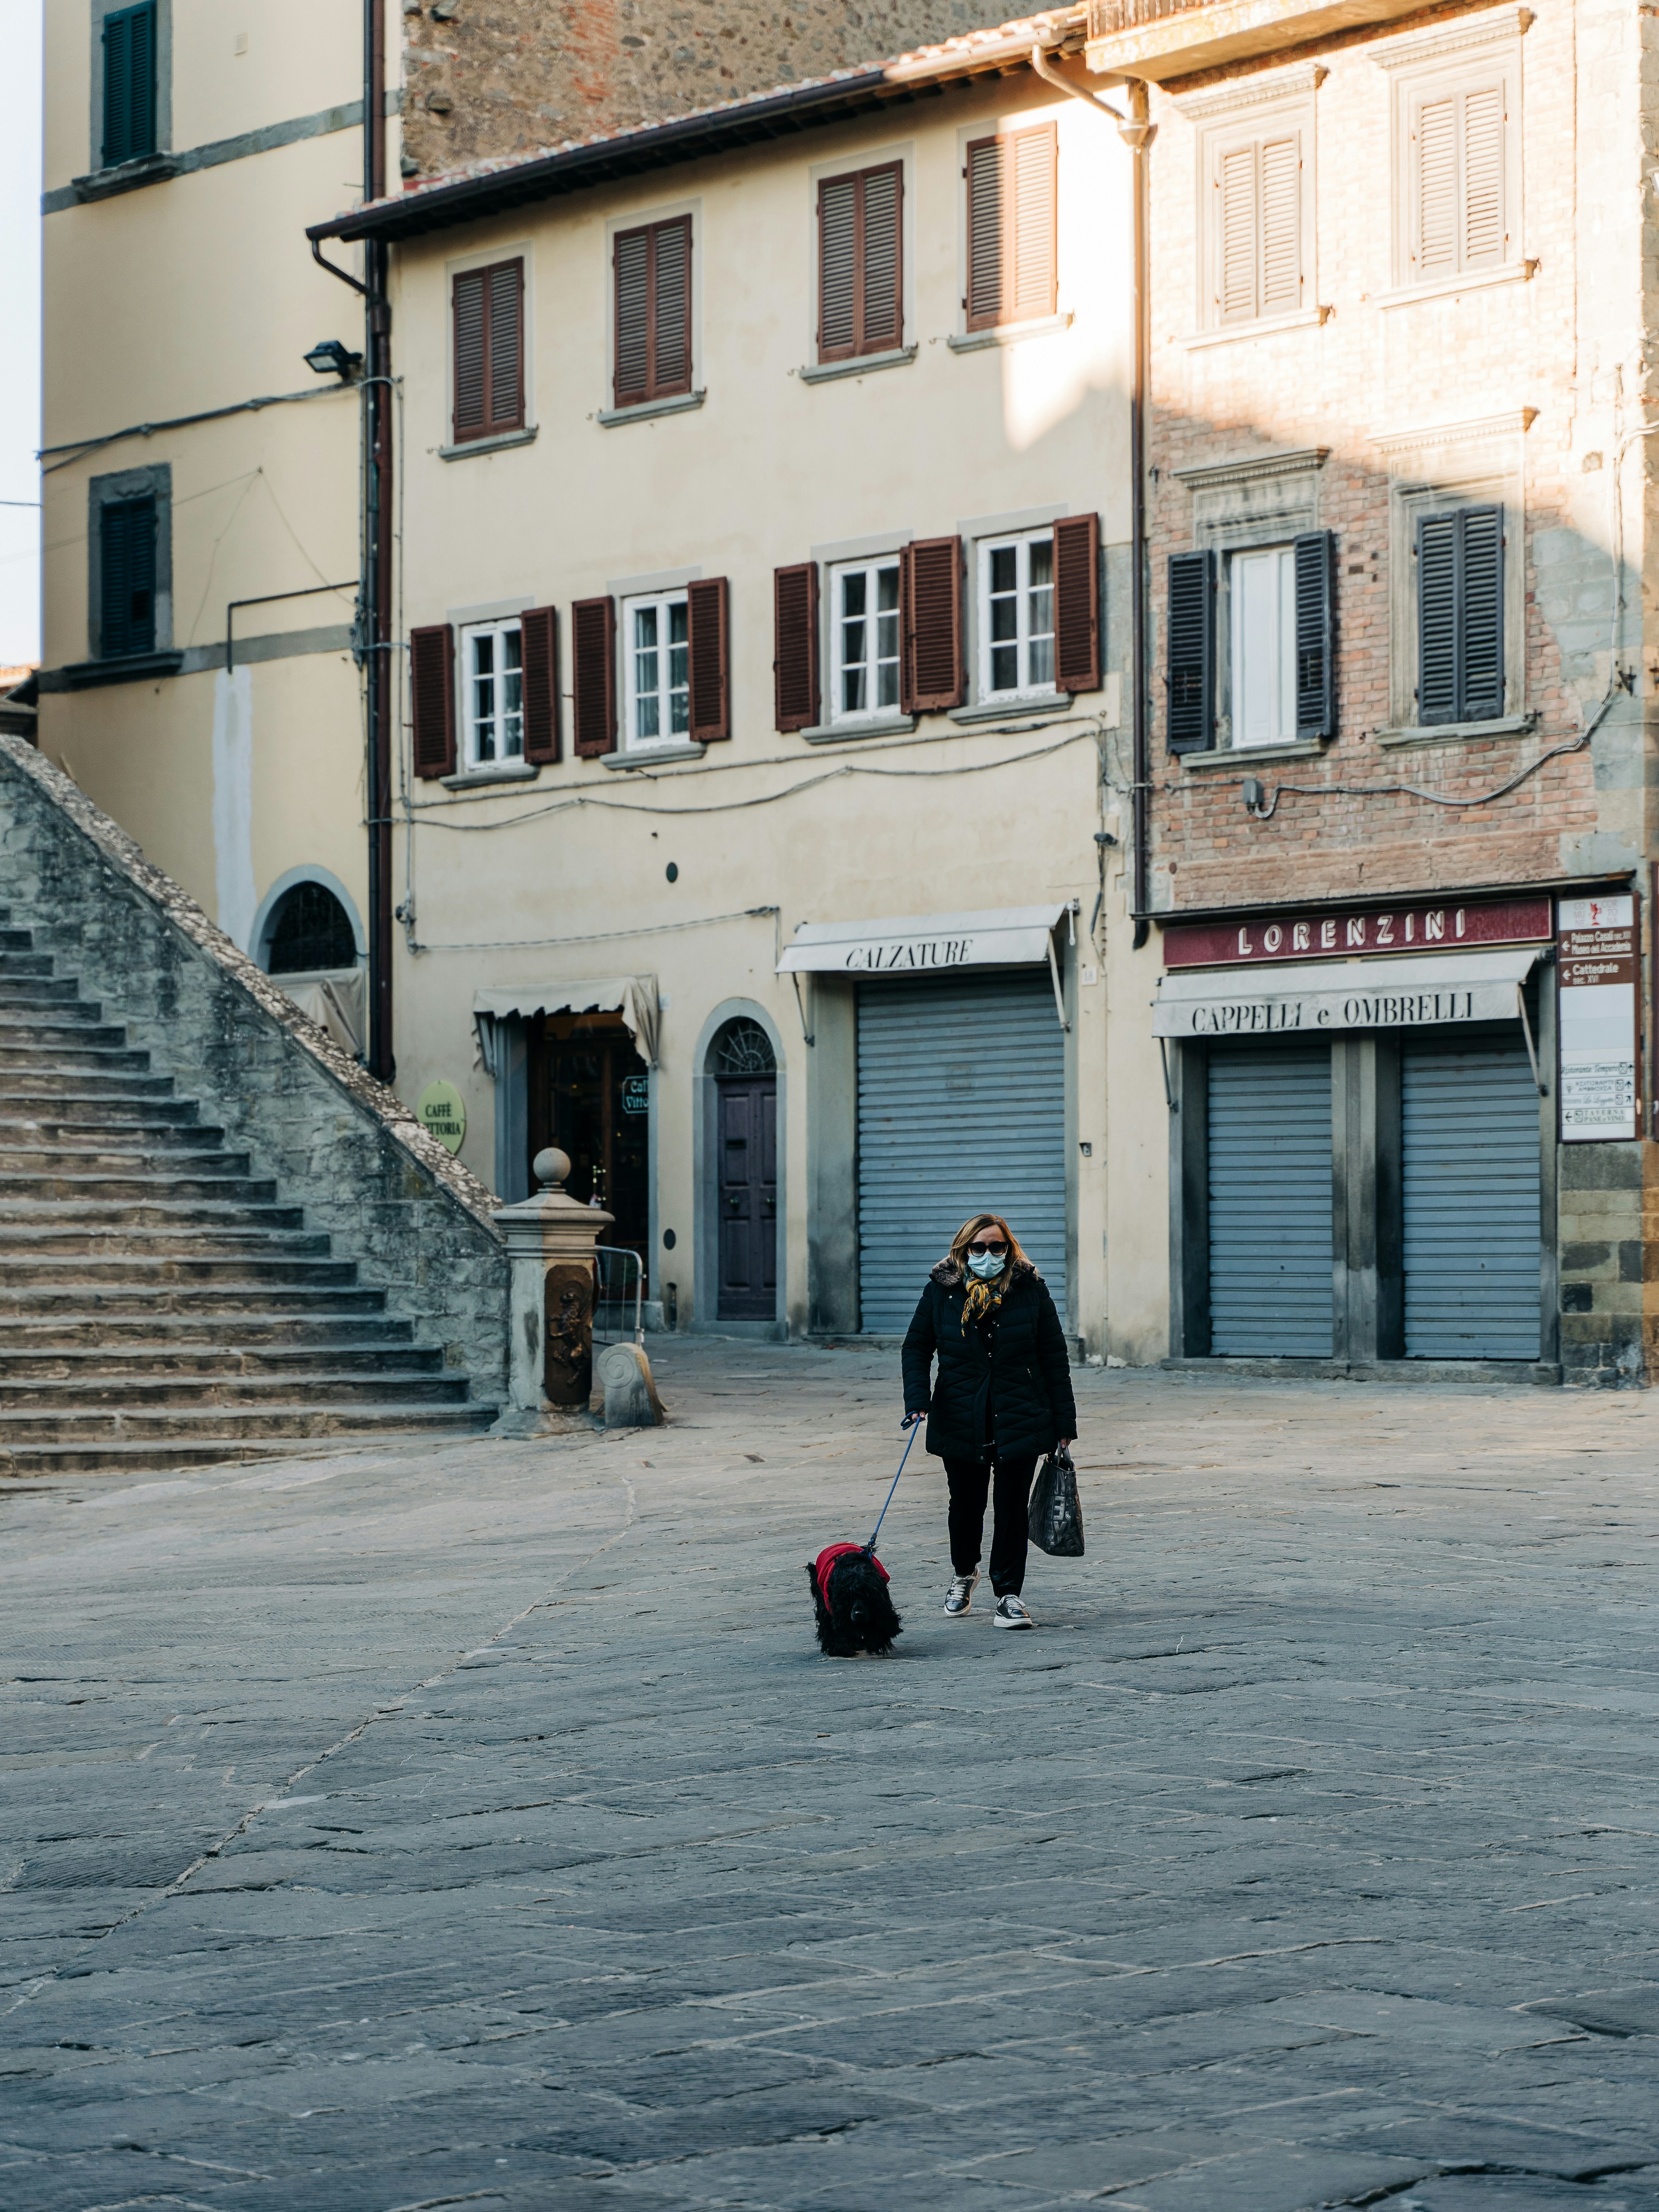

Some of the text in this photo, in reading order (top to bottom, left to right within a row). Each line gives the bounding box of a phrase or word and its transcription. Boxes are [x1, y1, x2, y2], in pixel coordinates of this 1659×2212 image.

[1238, 908, 1465, 955] LORENZINI
[1571, 932, 1595, 944] Palazzo
[1595, 930, 1614, 942] Casali
[846, 939, 973, 968] CALZATURE
[1571, 944, 1590, 955] Museo
[1572, 962, 1619, 976] Cattedrale
[1587, 974, 1600, 984] XVI
[1192, 992, 1474, 1034] CAPPELLI e OMBRELLI
[425, 1101, 452, 1117] CAFFÈ
